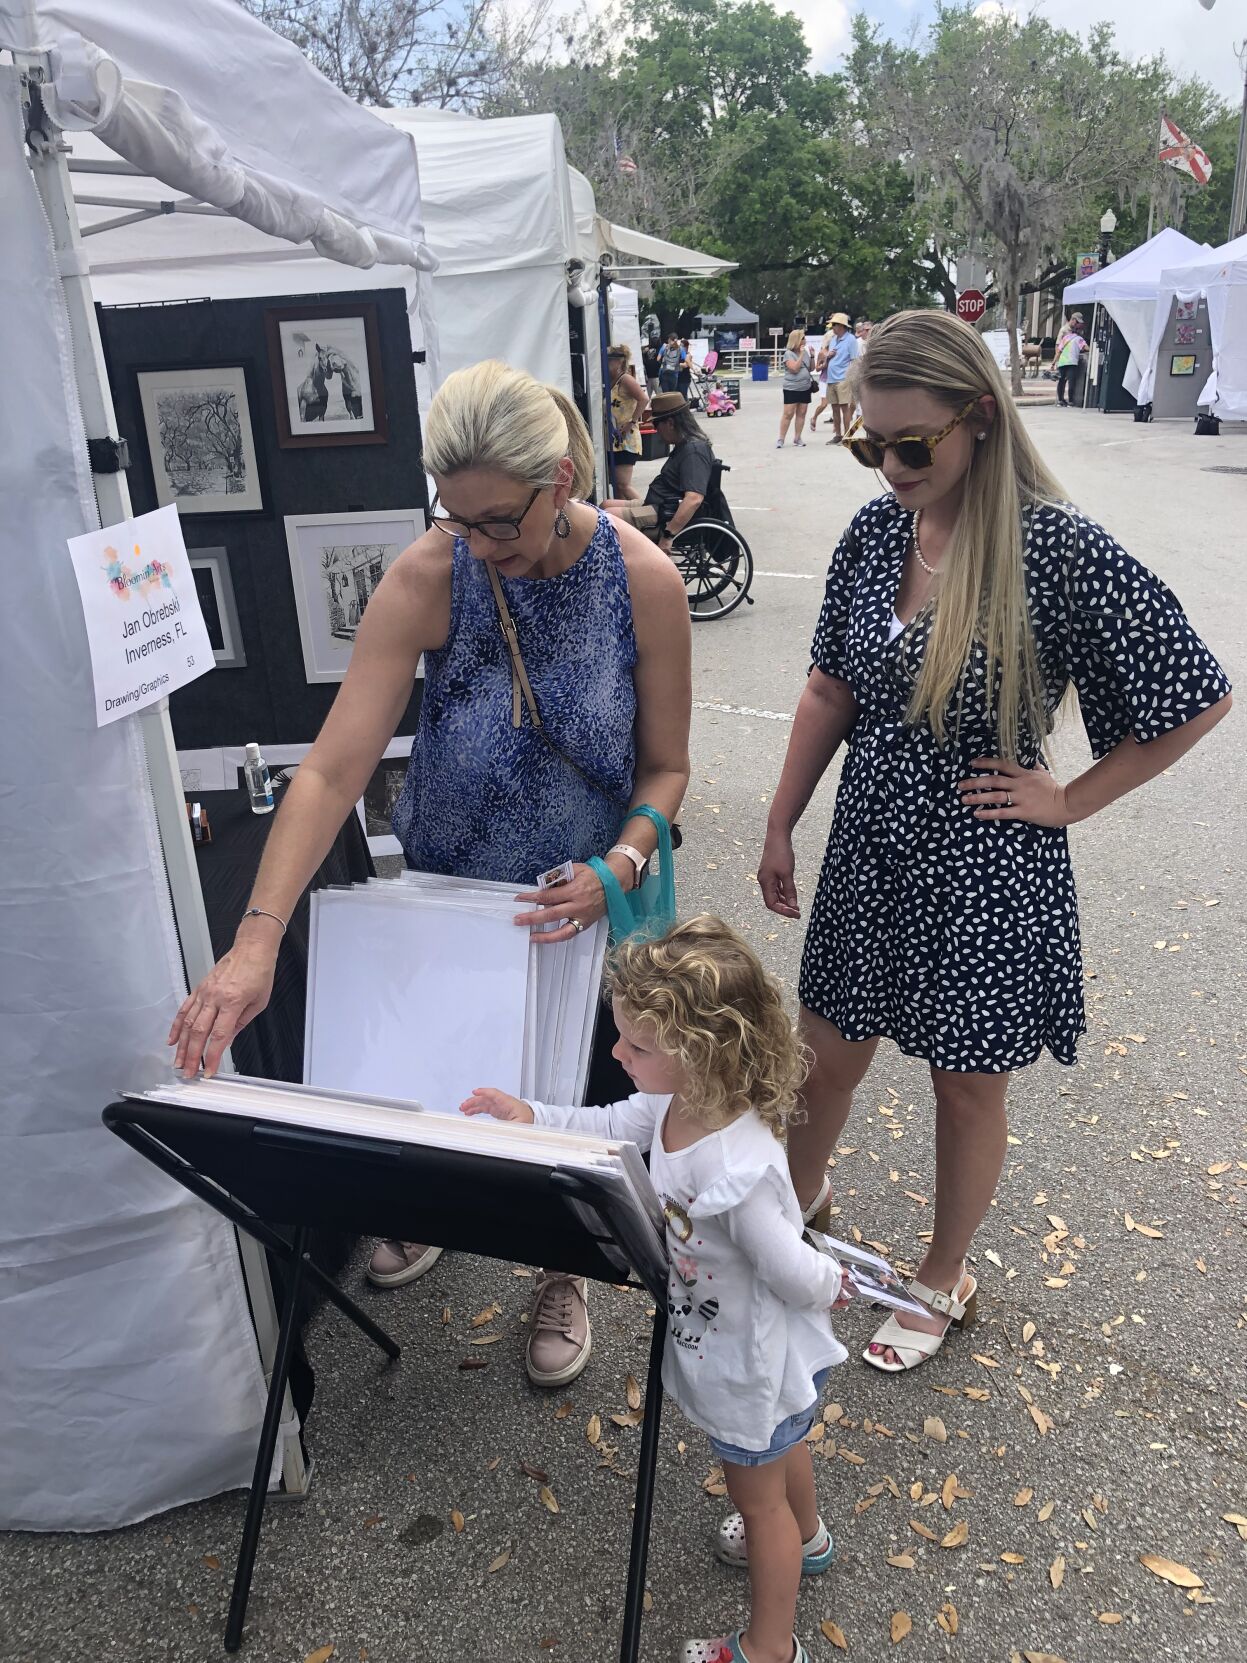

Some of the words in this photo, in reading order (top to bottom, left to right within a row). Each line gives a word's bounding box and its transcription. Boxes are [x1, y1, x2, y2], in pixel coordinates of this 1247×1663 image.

[958, 299, 984, 312] STOP
[122, 620, 141, 639] Jan
[142, 596, 181, 628] Obrebski
[125, 631, 175, 665] Inverness,
[174, 621, 188, 639] FL
[187, 655, 195, 668] 53
[105, 673, 170, 711] Drawing/Graphics
